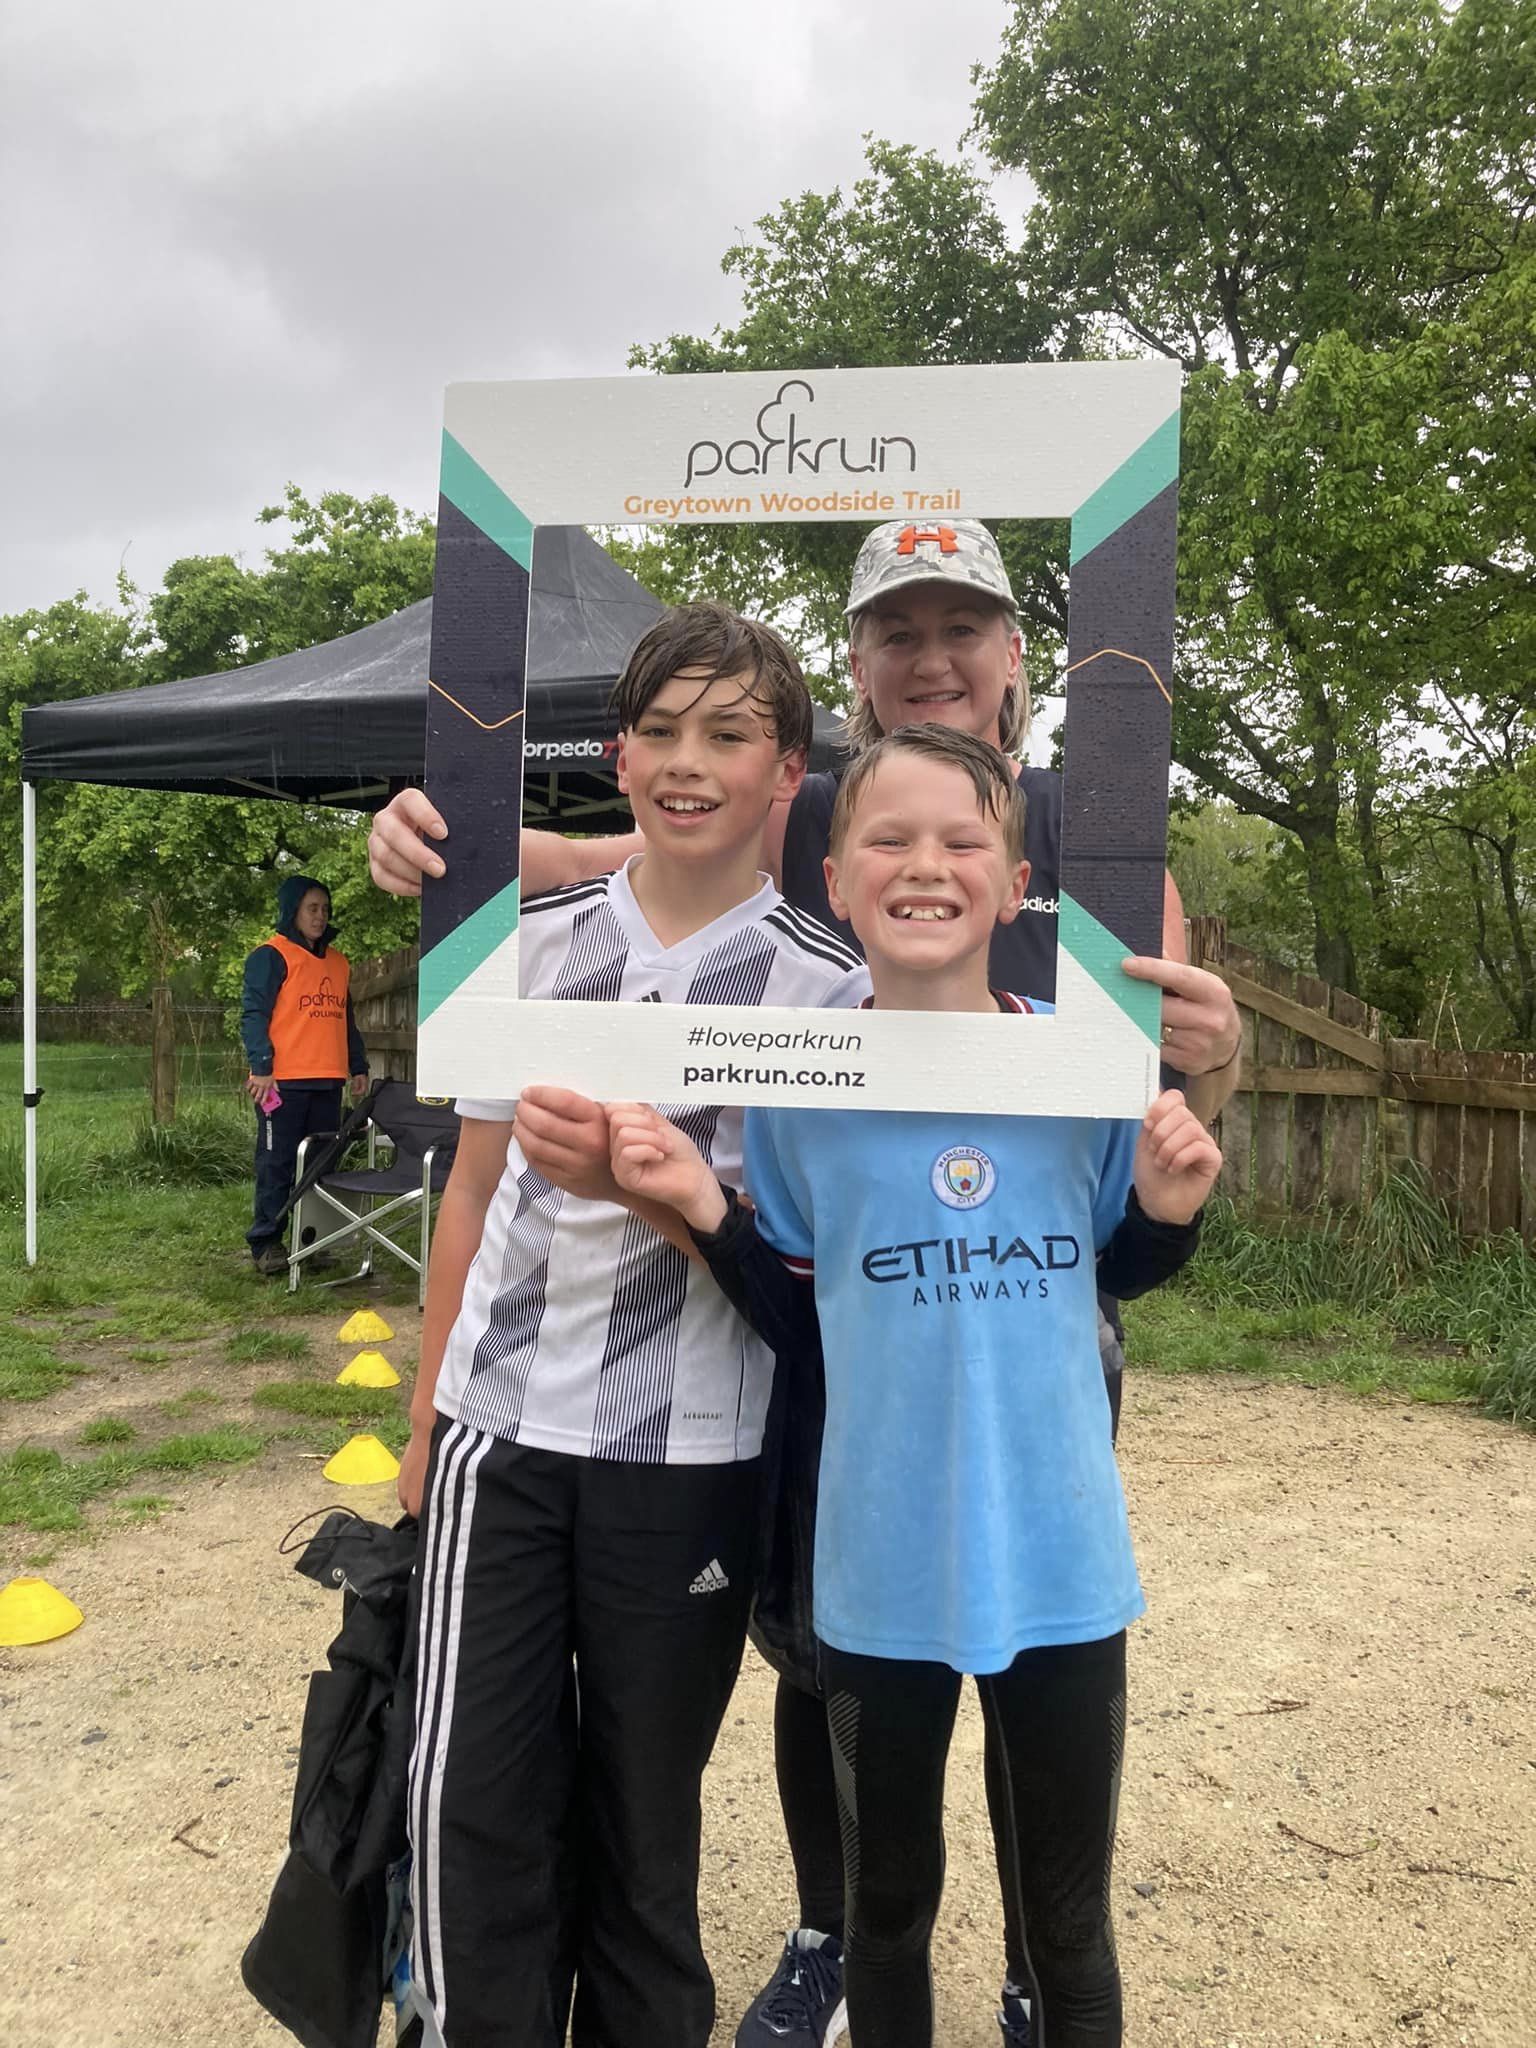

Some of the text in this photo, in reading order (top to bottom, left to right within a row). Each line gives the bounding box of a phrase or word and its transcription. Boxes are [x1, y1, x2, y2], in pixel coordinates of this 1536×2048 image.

[684, 379, 917, 489] parkrun
[624, 489, 961, 518] Greytown Woodside Trail
[523, 739, 618, 760] orpedo7
[687, 1026, 862, 1052] #loveparkrun
[683, 1063, 866, 1087] parkrun.co.nz
[938, 1148, 990, 1168] MANCHESTER
[957, 1196, 977, 1204] CITY
[862, 1235, 1080, 1283] ETIHAD
[913, 1278, 1049, 1306] AIRWAYS
